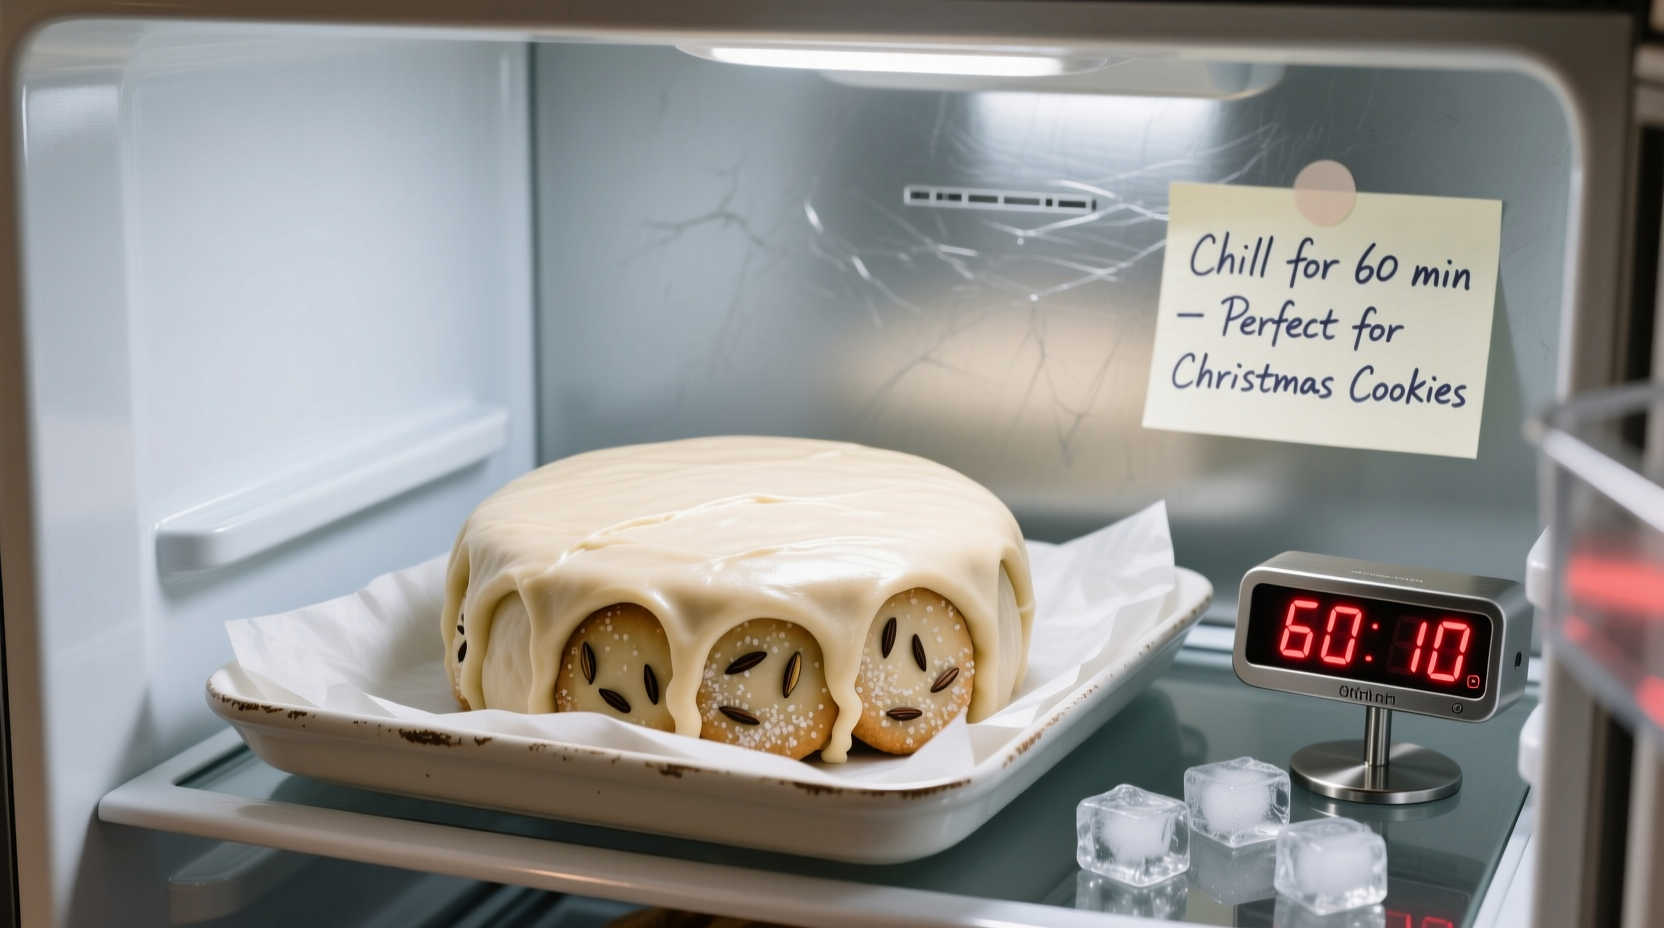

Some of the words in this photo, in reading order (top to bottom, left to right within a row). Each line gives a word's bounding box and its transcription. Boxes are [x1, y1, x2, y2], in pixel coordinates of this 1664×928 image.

[1190, 231, 1274, 279] Chill
[1285, 236, 1341, 289] for
[1354, 242, 1399, 285] 60
[1410, 258, 1471, 291] min
[1221, 295, 1340, 348] Perfect
[1351, 305, 1405, 352] for
[1172, 352, 1335, 399] Christmas
[1349, 364, 1467, 409] Cookies
[1278, 598, 1472, 684] 60:10
